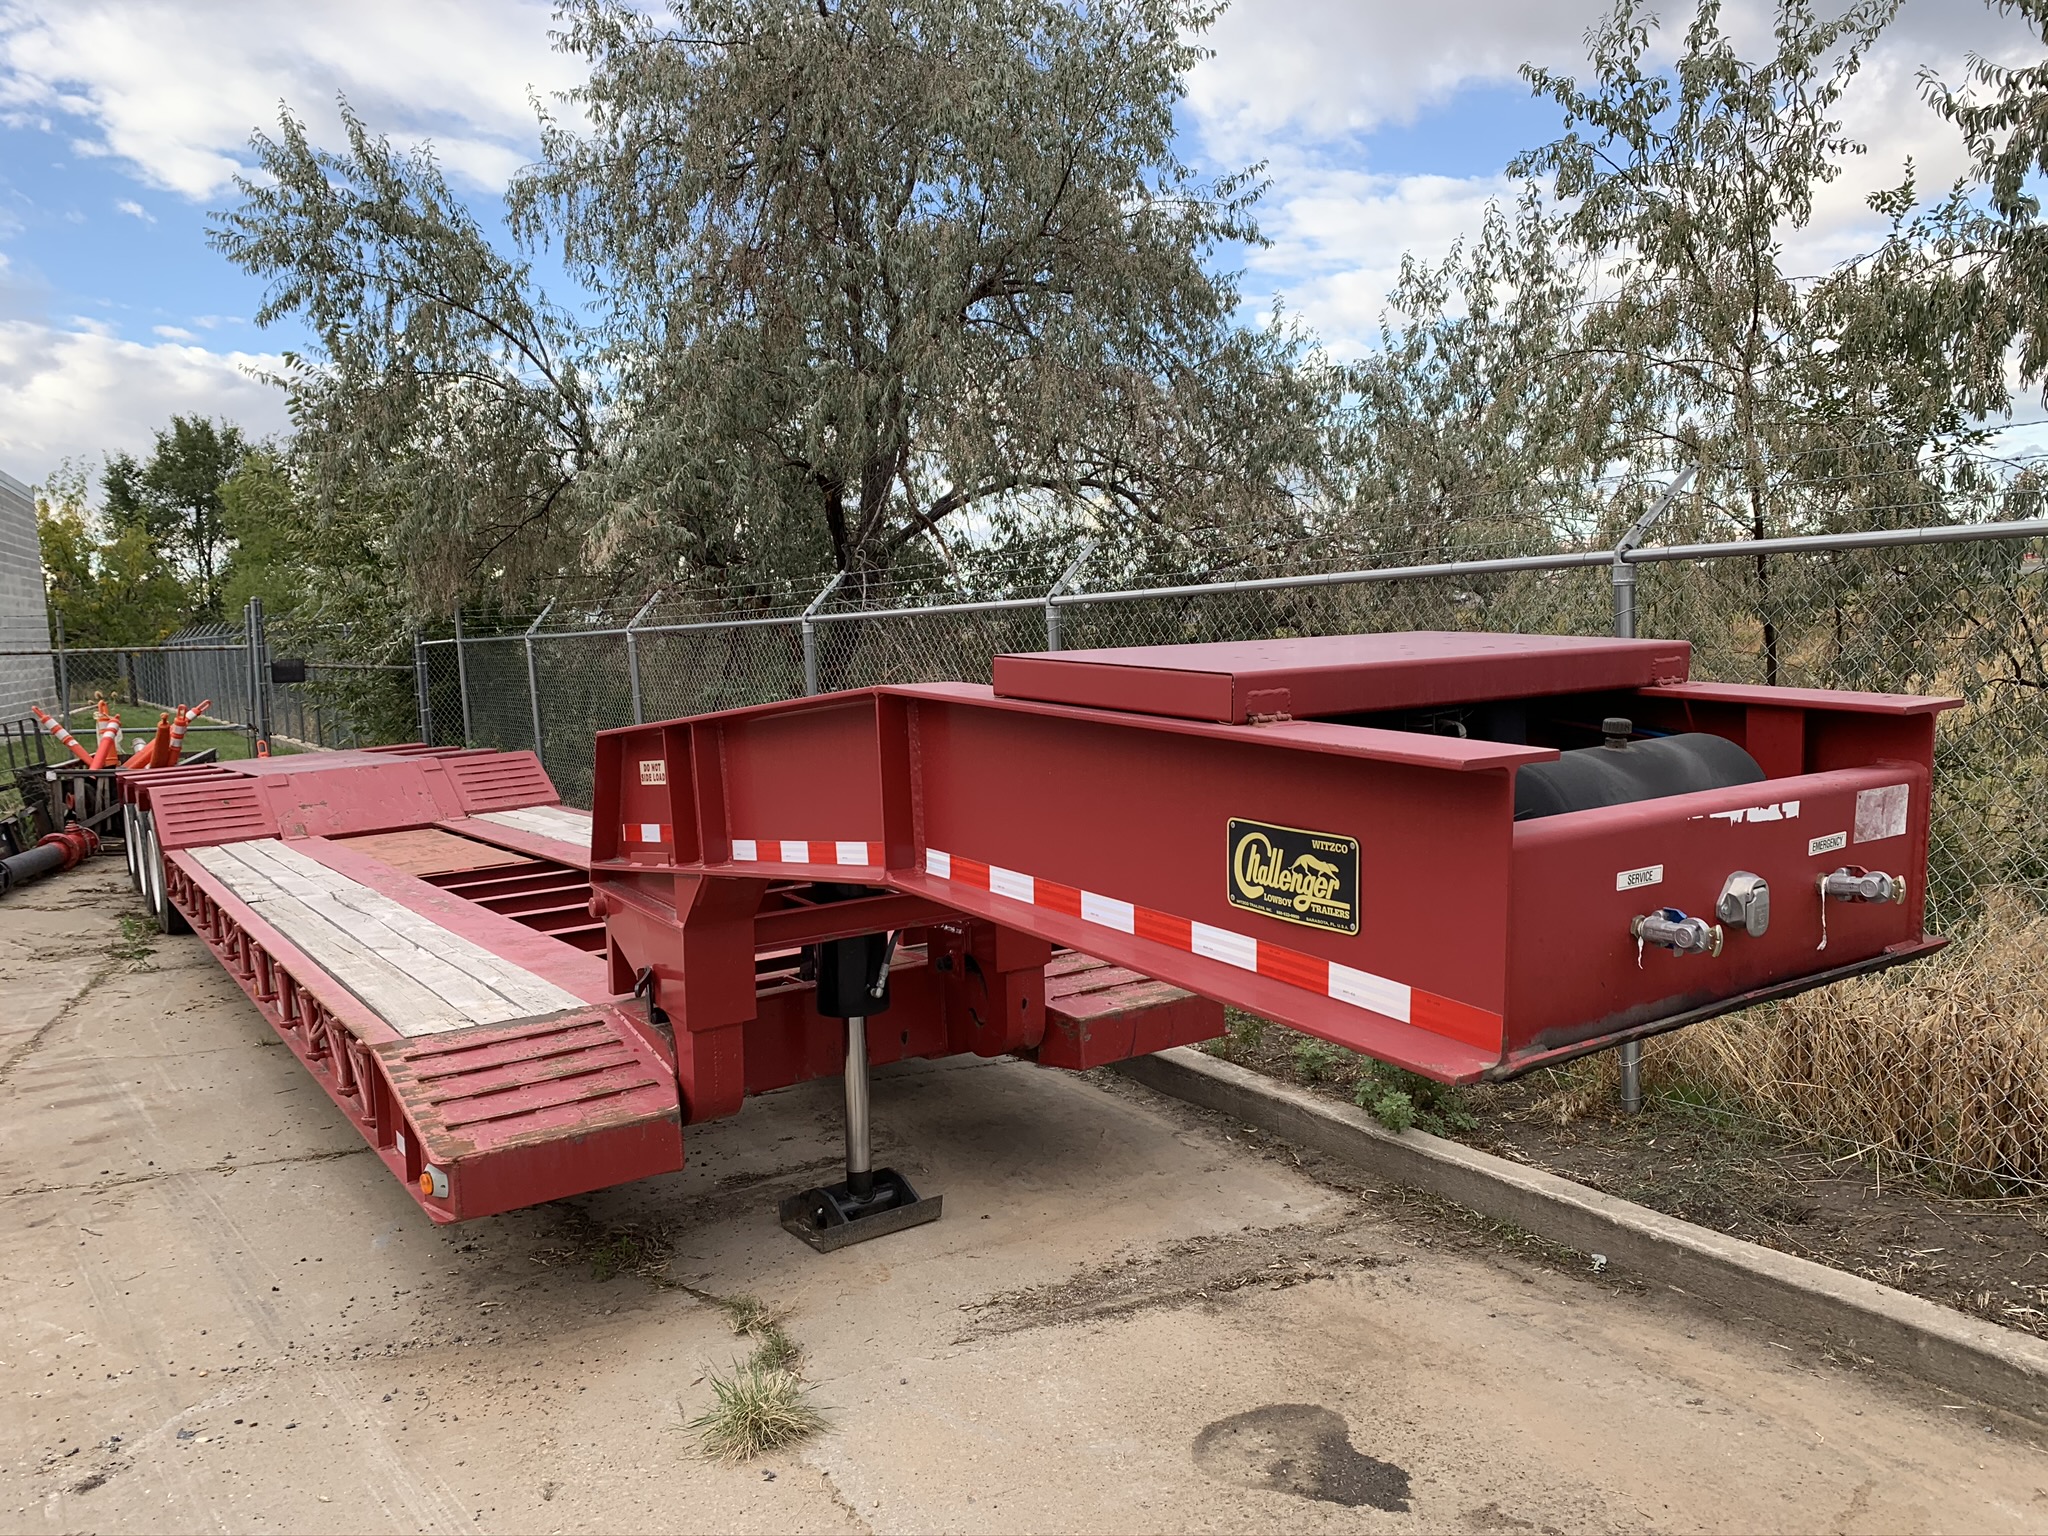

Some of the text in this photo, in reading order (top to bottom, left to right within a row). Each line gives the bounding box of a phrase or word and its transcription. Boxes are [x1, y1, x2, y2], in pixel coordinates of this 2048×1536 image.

[643, 763, 661, 772] DO NOT
[641, 773, 665, 782] SIDE LOAD
[1311, 839, 1348, 854] WITZCO
[1812, 835, 1844, 852] EMERGENCY
[1234, 832, 1350, 912] Challenger
[1627, 870, 1653, 886] SERVICE
[1263, 893, 1293, 908] LOWBOY
[1310, 903, 1350, 920] TRAILERS
